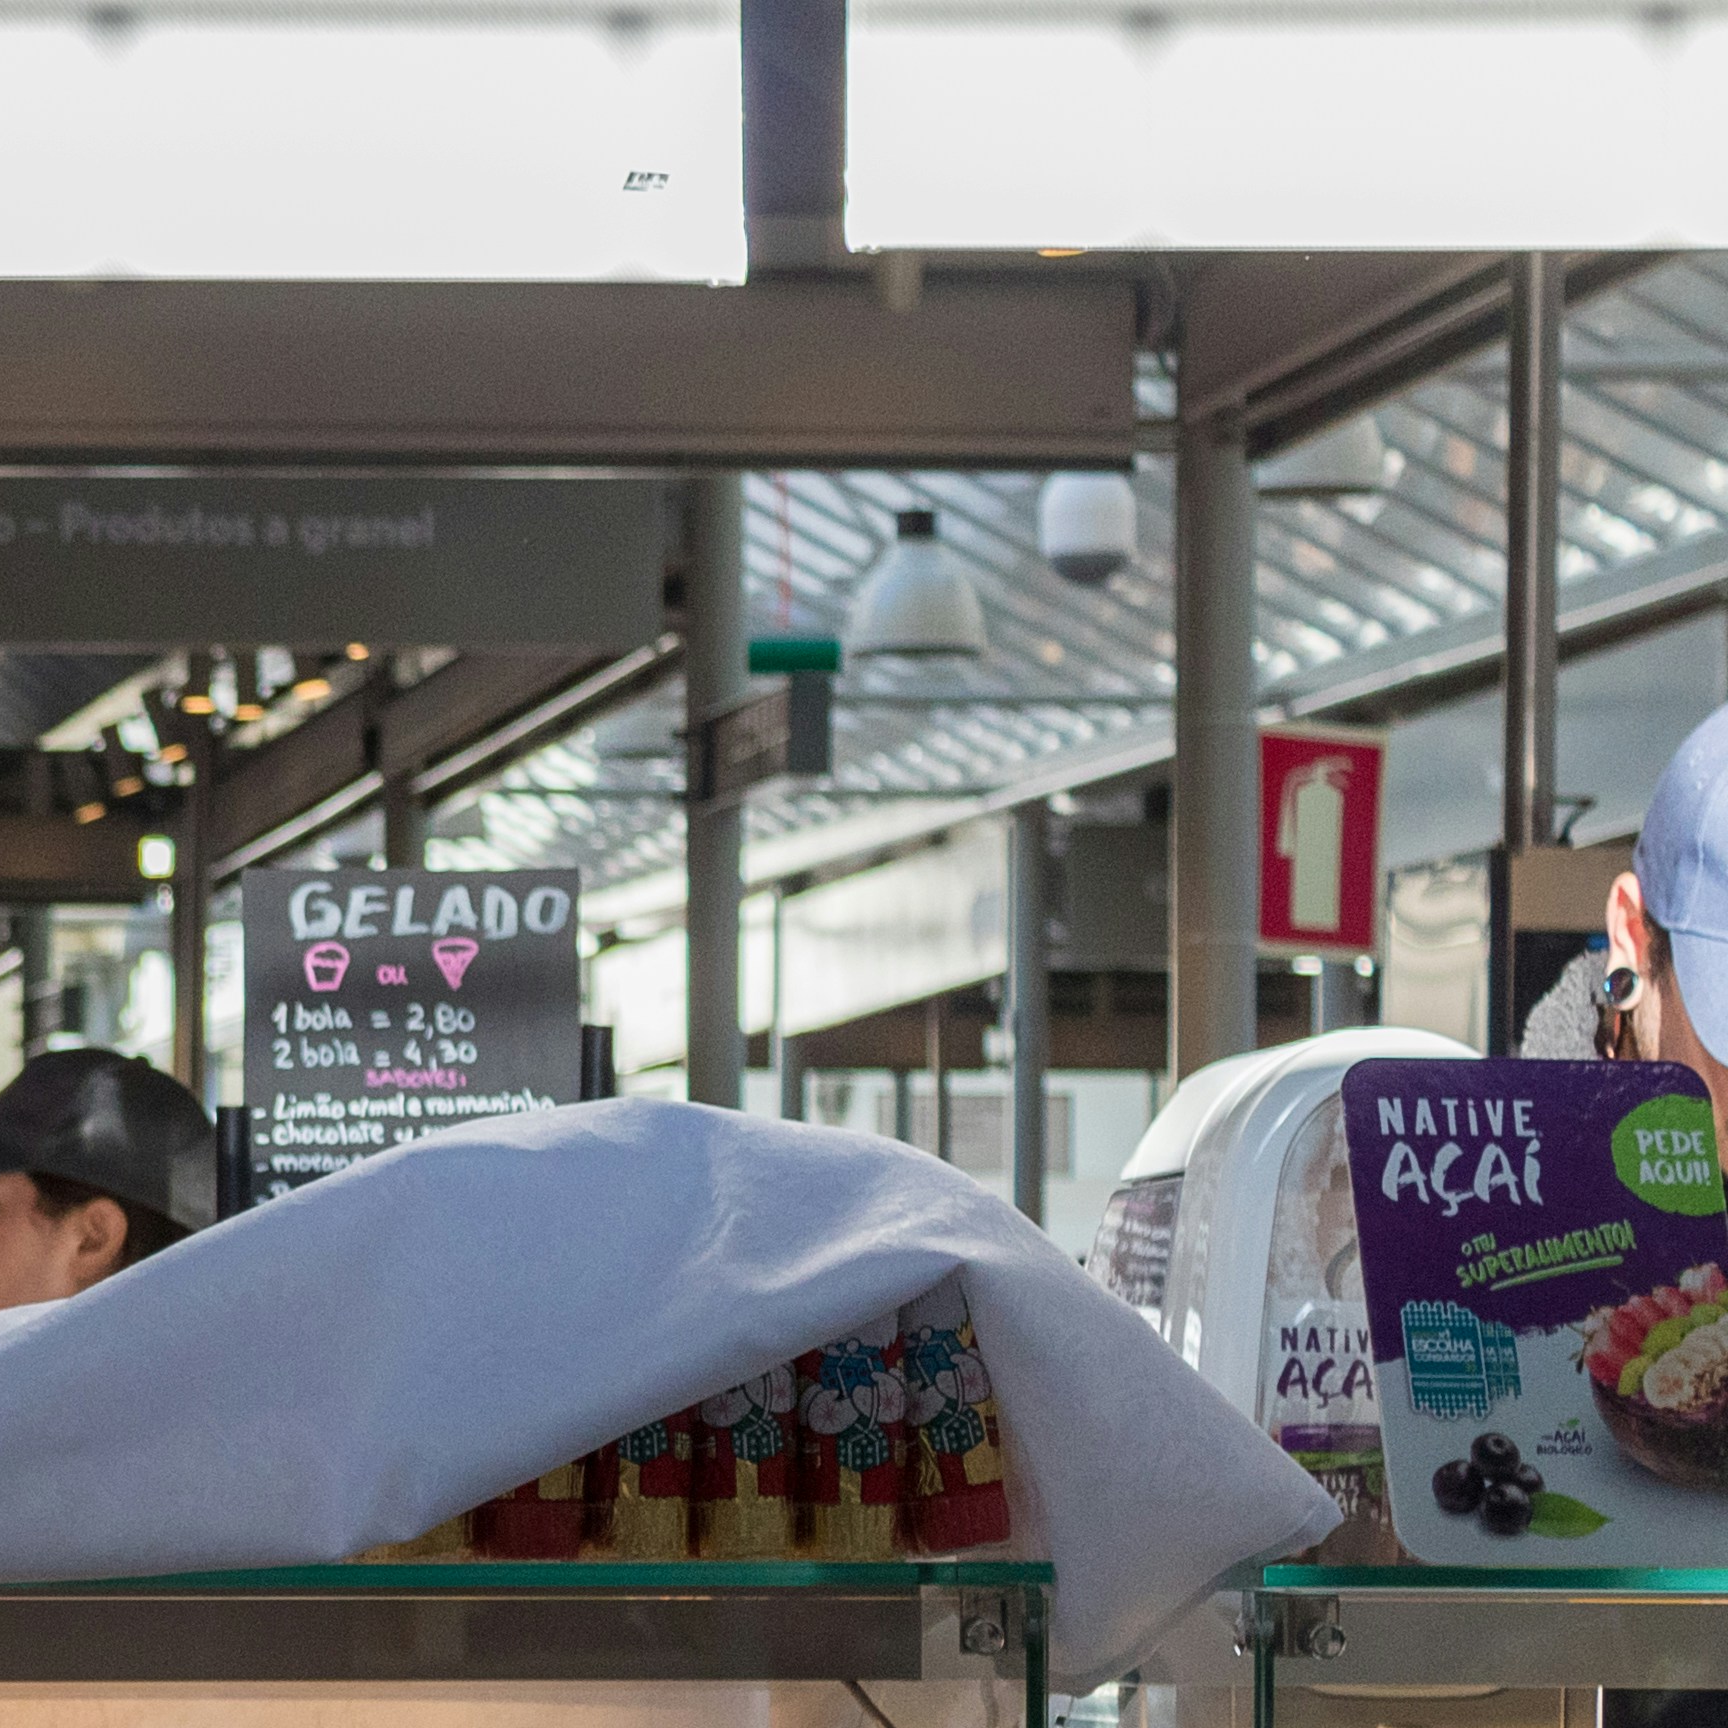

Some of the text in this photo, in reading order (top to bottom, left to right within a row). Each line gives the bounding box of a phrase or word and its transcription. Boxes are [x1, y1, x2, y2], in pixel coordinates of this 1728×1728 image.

[59, 502, 254, 546] Produtos
[263, 515, 290, 544] a
[298, 504, 435, 555] granel
[290, 882, 571, 940] GELADO
[377, 965, 407, 986] ou
[296, 1003, 351, 1032] bola
[406, 1003, 476, 1041] 2,80
[272, 1046, 293, 1069] 2
[300, 1039, 360, 1067] bola
[404, 1041, 477, 1070] 4,30
[273, 1093, 345, 1121] Limão
[1636, 1128, 1706, 1156] PEDE
[1381, 1139, 1544, 1217] AÇAÍ
[1455, 1220, 1637, 1288] SUPERALIMENTO!
[1276, 1357, 1374, 1408] AÇA
